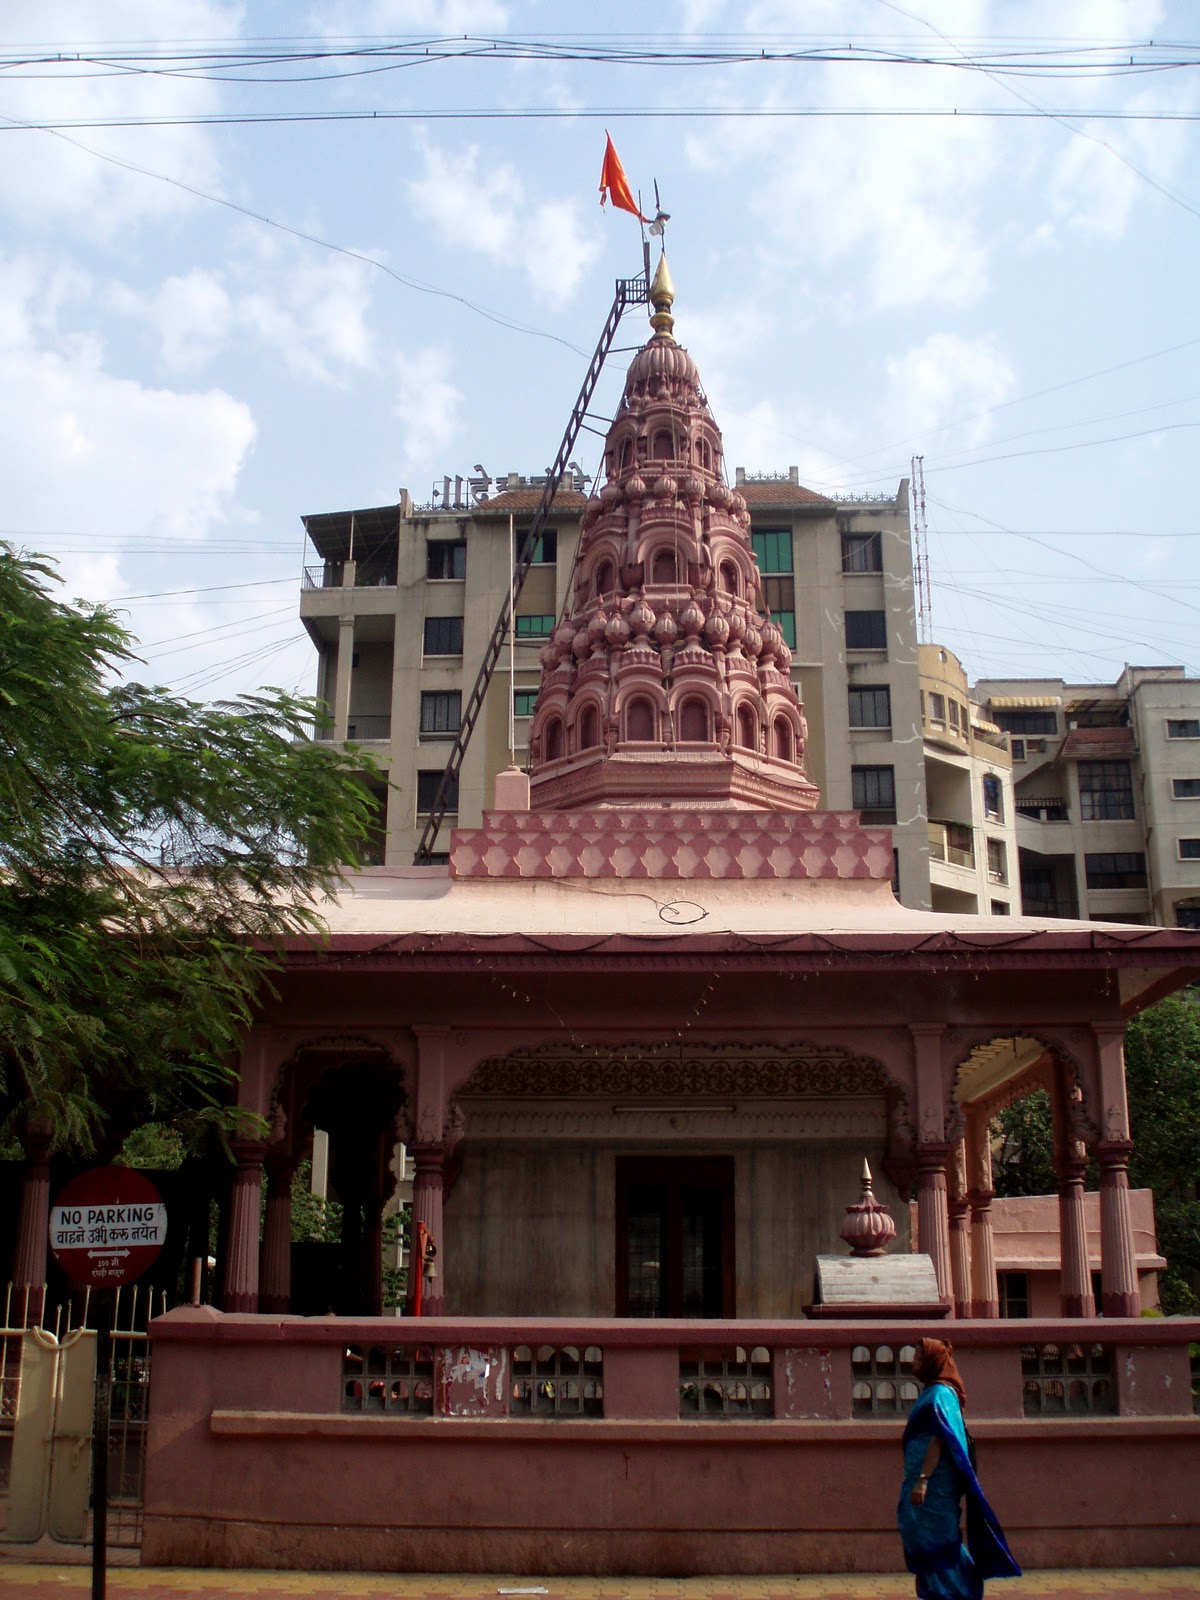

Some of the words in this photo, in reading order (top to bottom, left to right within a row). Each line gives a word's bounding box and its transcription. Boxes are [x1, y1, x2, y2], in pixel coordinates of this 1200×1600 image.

[61, 1210, 82, 1225] NO
[88, 1207, 154, 1224] PARKING
[57, 1226, 86, 1245] वाहने
[87, 1224, 108, 1244] उभी
[131, 1222, 159, 1241] नयेत
